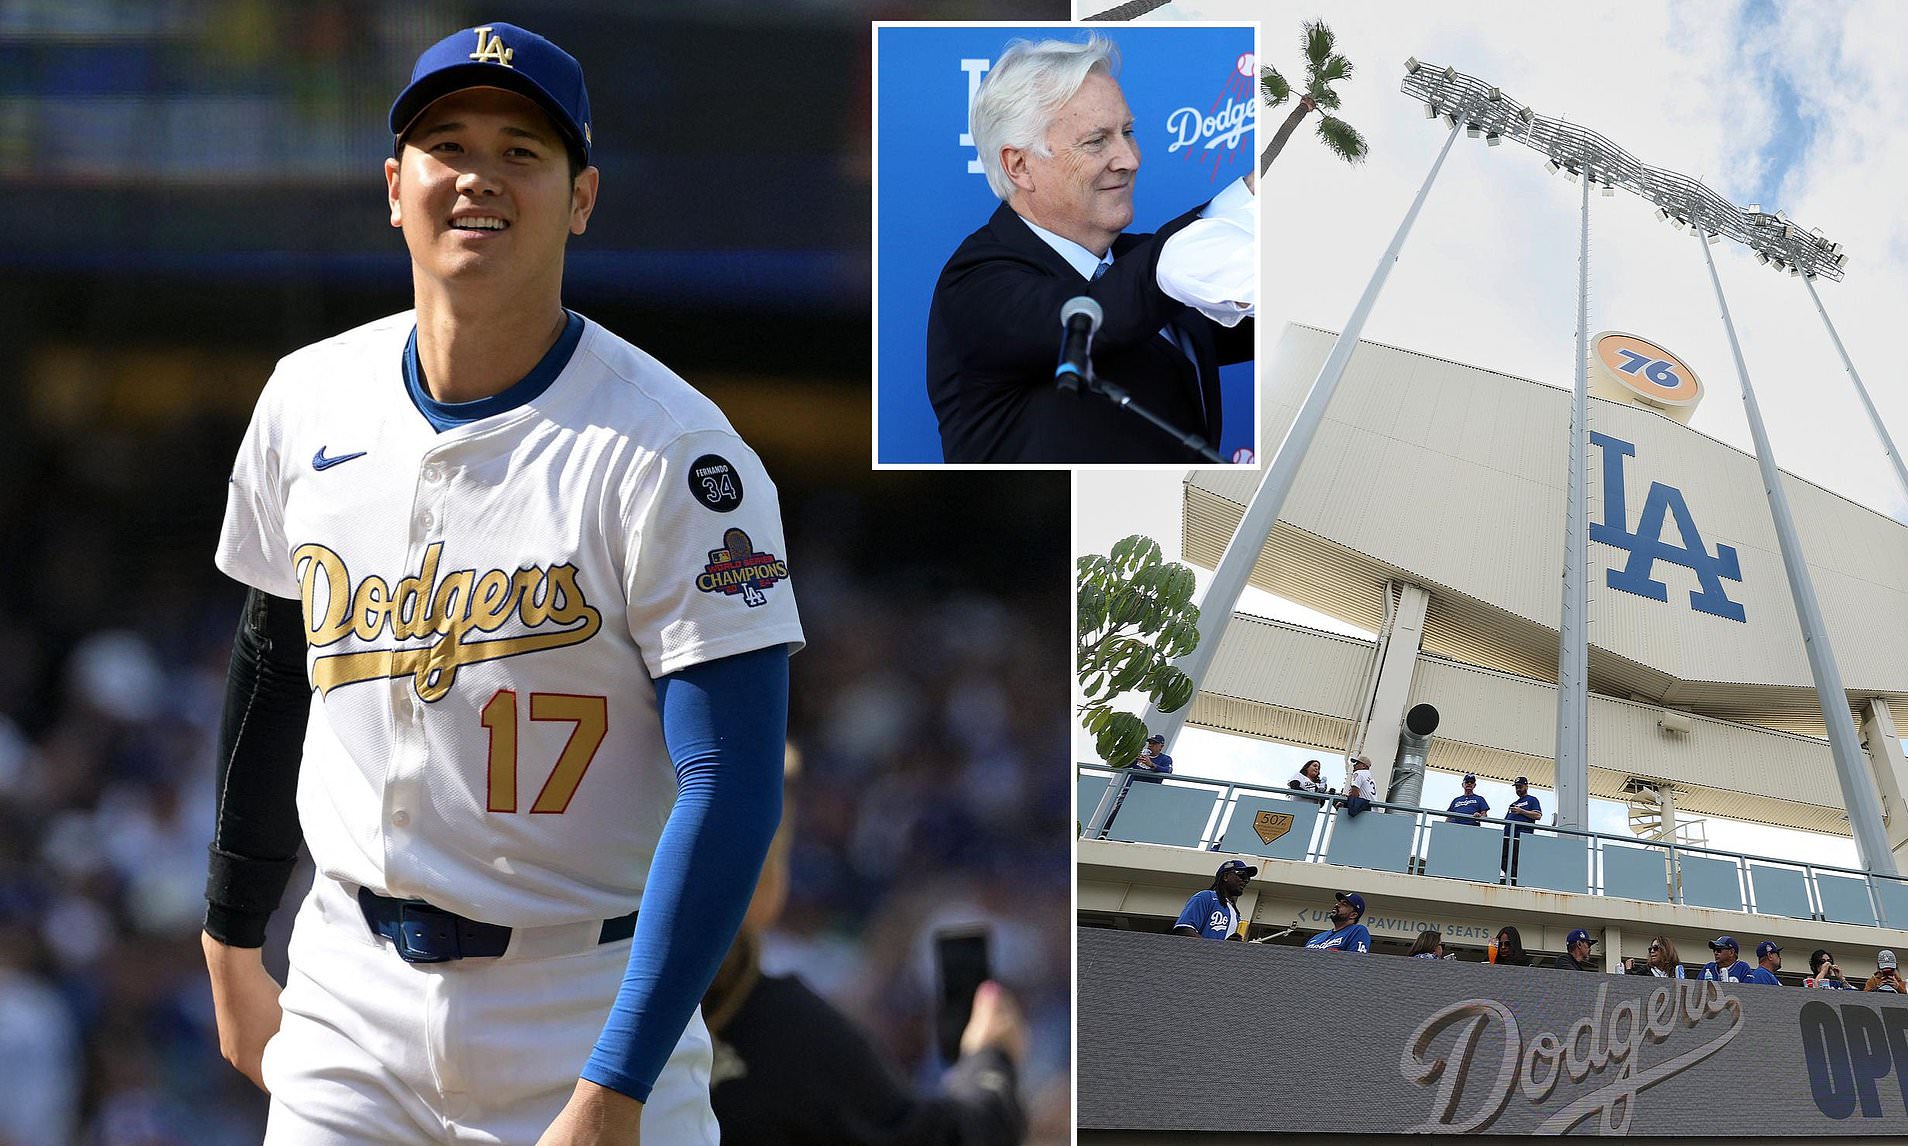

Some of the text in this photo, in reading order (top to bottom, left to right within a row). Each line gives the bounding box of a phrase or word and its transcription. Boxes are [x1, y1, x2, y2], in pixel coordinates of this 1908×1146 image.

[470, 26, 514, 68] LA
[1616, 348, 1681, 389] 76
[695, 465, 728, 477] FERNANDO
[702, 474, 737, 502] 34
[1589, 430, 1746, 623] LA
[698, 561, 788, 590] CHAMPIONS
[741, 582, 765, 605] LA
[292, 541, 602, 703] Dodgers
[481, 689, 608, 814] 17
[1261, 814, 1287, 826] 507
[1366, 916, 1489, 939] PAVILION SEATS
[1357, 941, 1367, 953] LA
[1400, 980, 1745, 1135] Dodgers
